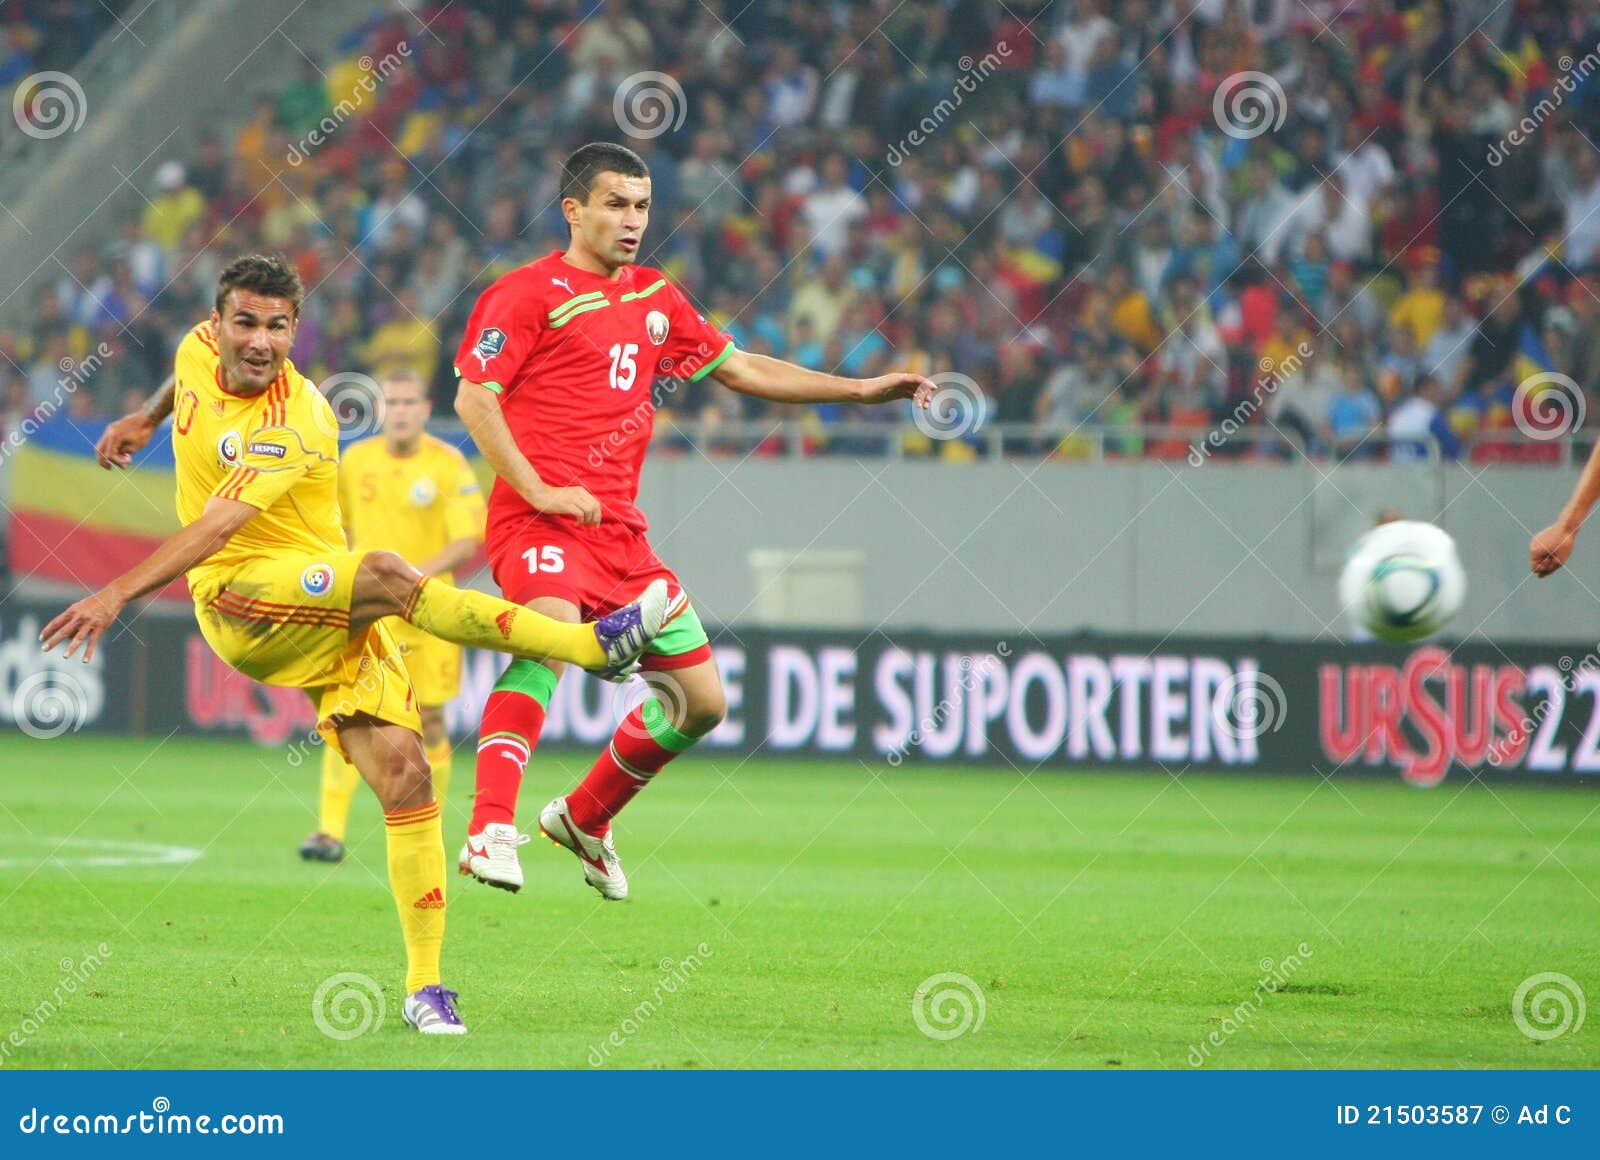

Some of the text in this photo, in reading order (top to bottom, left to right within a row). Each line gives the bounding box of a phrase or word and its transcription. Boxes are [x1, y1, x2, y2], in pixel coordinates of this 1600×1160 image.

[609, 342, 639, 391] 15
[521, 545, 565, 575] 15
[766, 645, 858, 753] DE
[872, 646, 1260, 764] SUPORTERI
